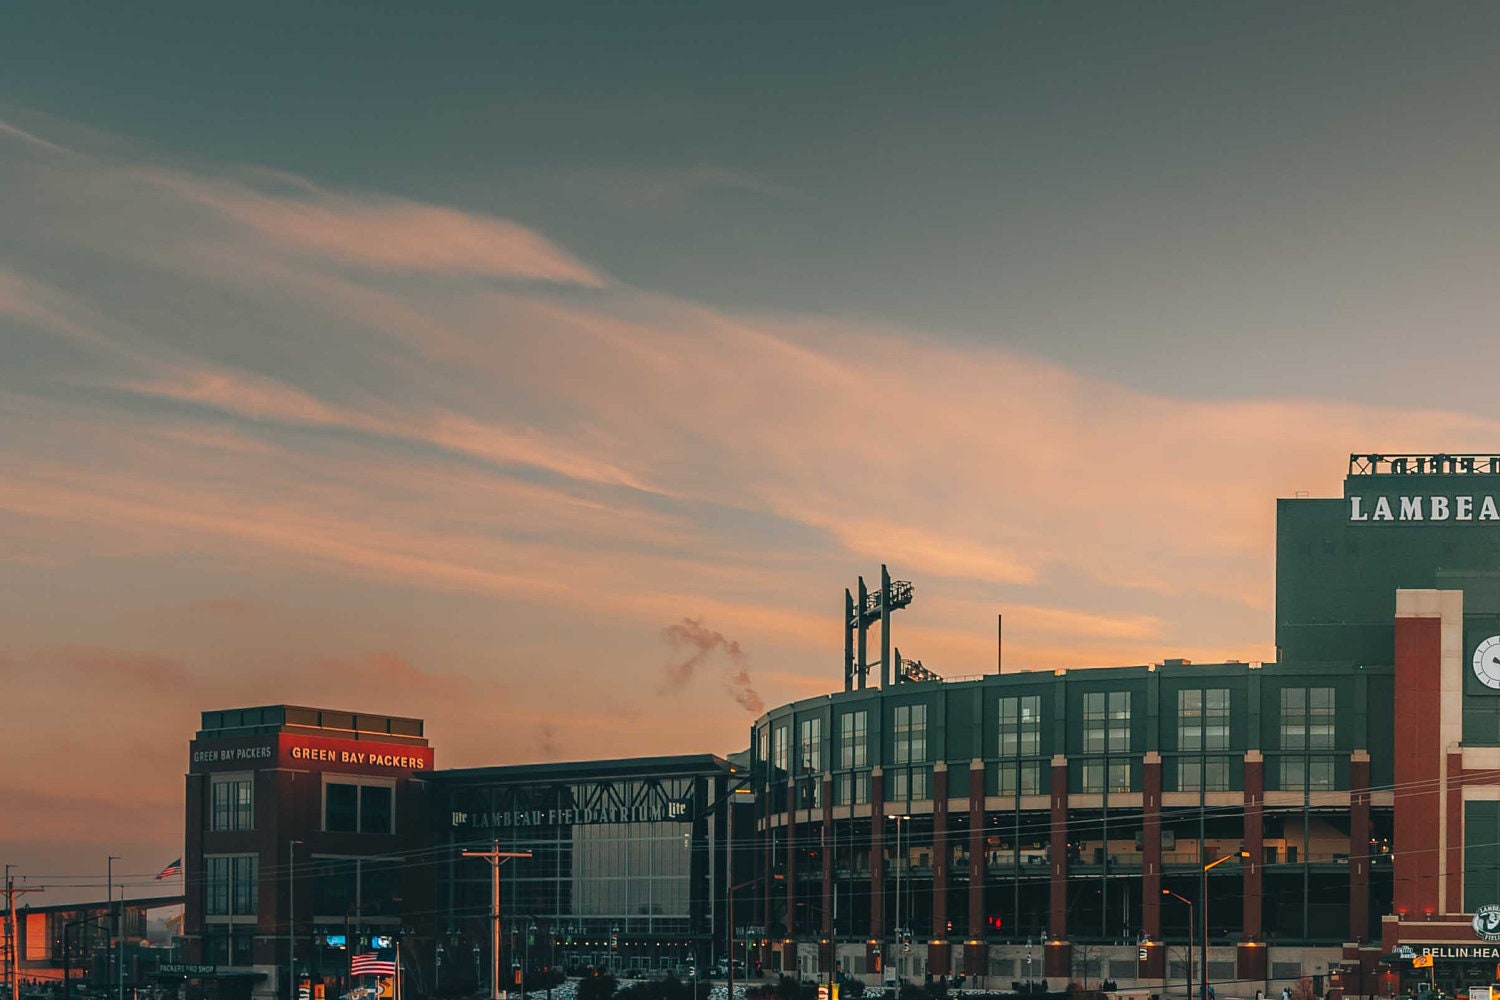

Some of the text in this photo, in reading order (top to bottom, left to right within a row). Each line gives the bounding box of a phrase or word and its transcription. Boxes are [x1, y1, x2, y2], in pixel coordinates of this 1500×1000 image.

[194, 746, 271, 762] GREEN BAY PACKERS
[292, 747, 424, 769] GREEN BAY PACKERS
[472, 806, 662, 828] LAMBEAU FIELD ATRIUM
[668, 802, 686, 818] Lite
[452, 812, 467, 826] Lite
[1422, 947, 1469, 958] BELLIN
[198, 965, 214, 973] SHOP
